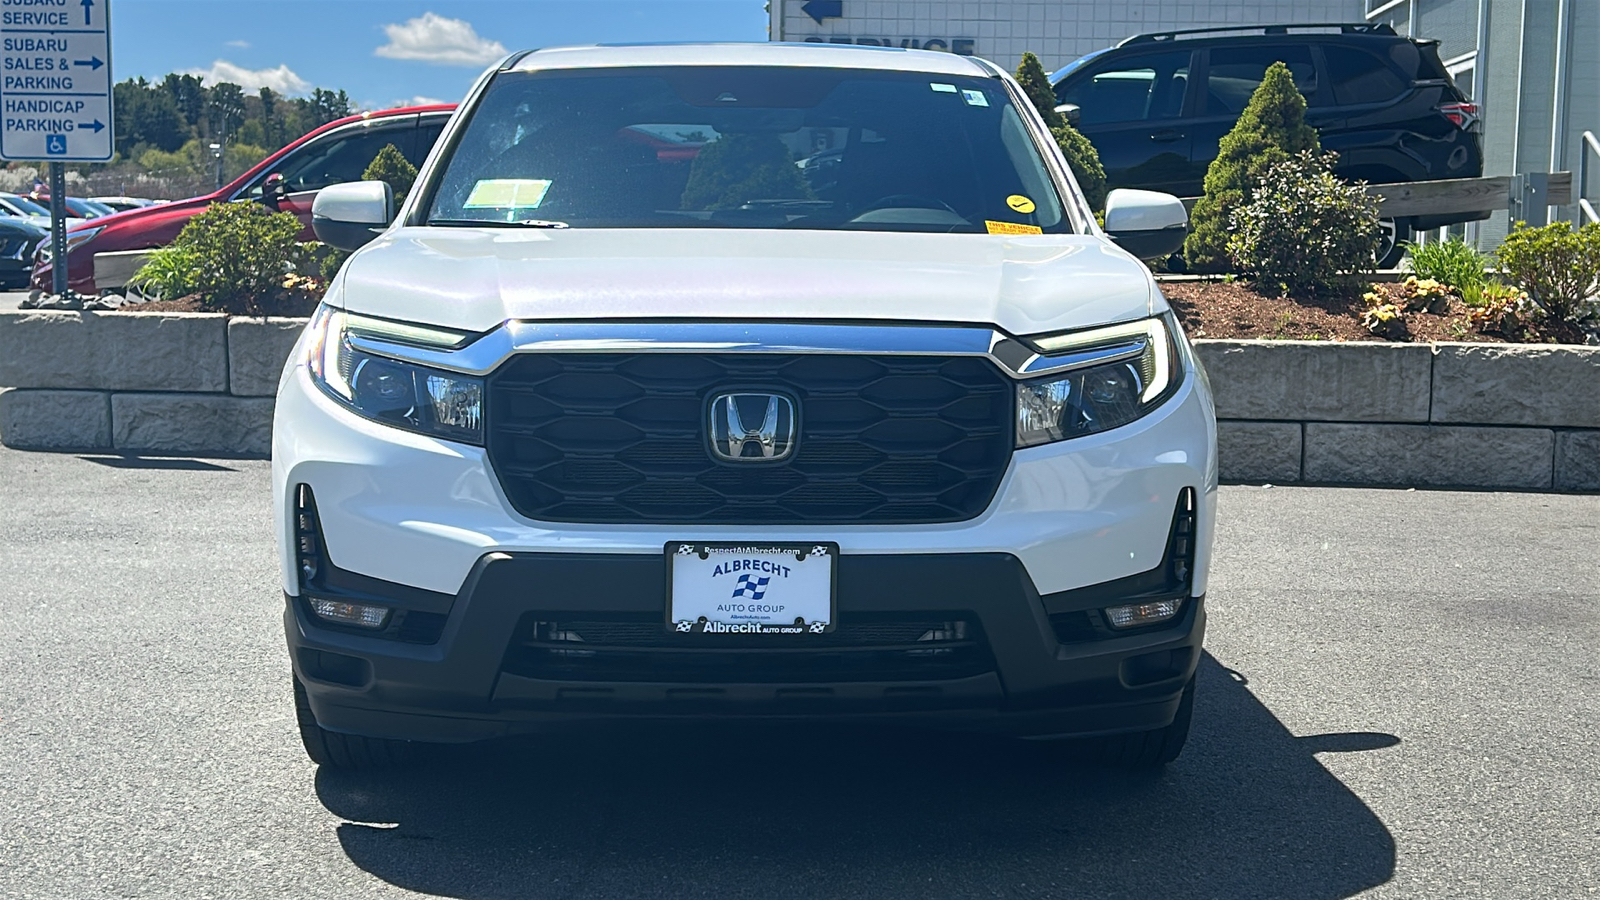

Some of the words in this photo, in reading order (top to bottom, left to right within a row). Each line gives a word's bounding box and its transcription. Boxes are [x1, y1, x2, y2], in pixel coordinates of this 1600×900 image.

[3, 12, 69, 25] SERVICE
[3, 38, 67, 51] SUBARU
[4, 58, 54, 70] SALES
[59, 58, 69, 71] &
[5, 77, 73, 89] PARKING
[6, 100, 85, 113] HANDICAP
[6, 119, 74, 132] PARKING
[704, 547, 800, 555] RespectAtAlbrecht.com
[712, 559, 791, 578] ALBRECHT
[717, 604, 745, 612] AUTO
[748, 604, 785, 613] GROUP
[702, 621, 762, 633] Albrecht
